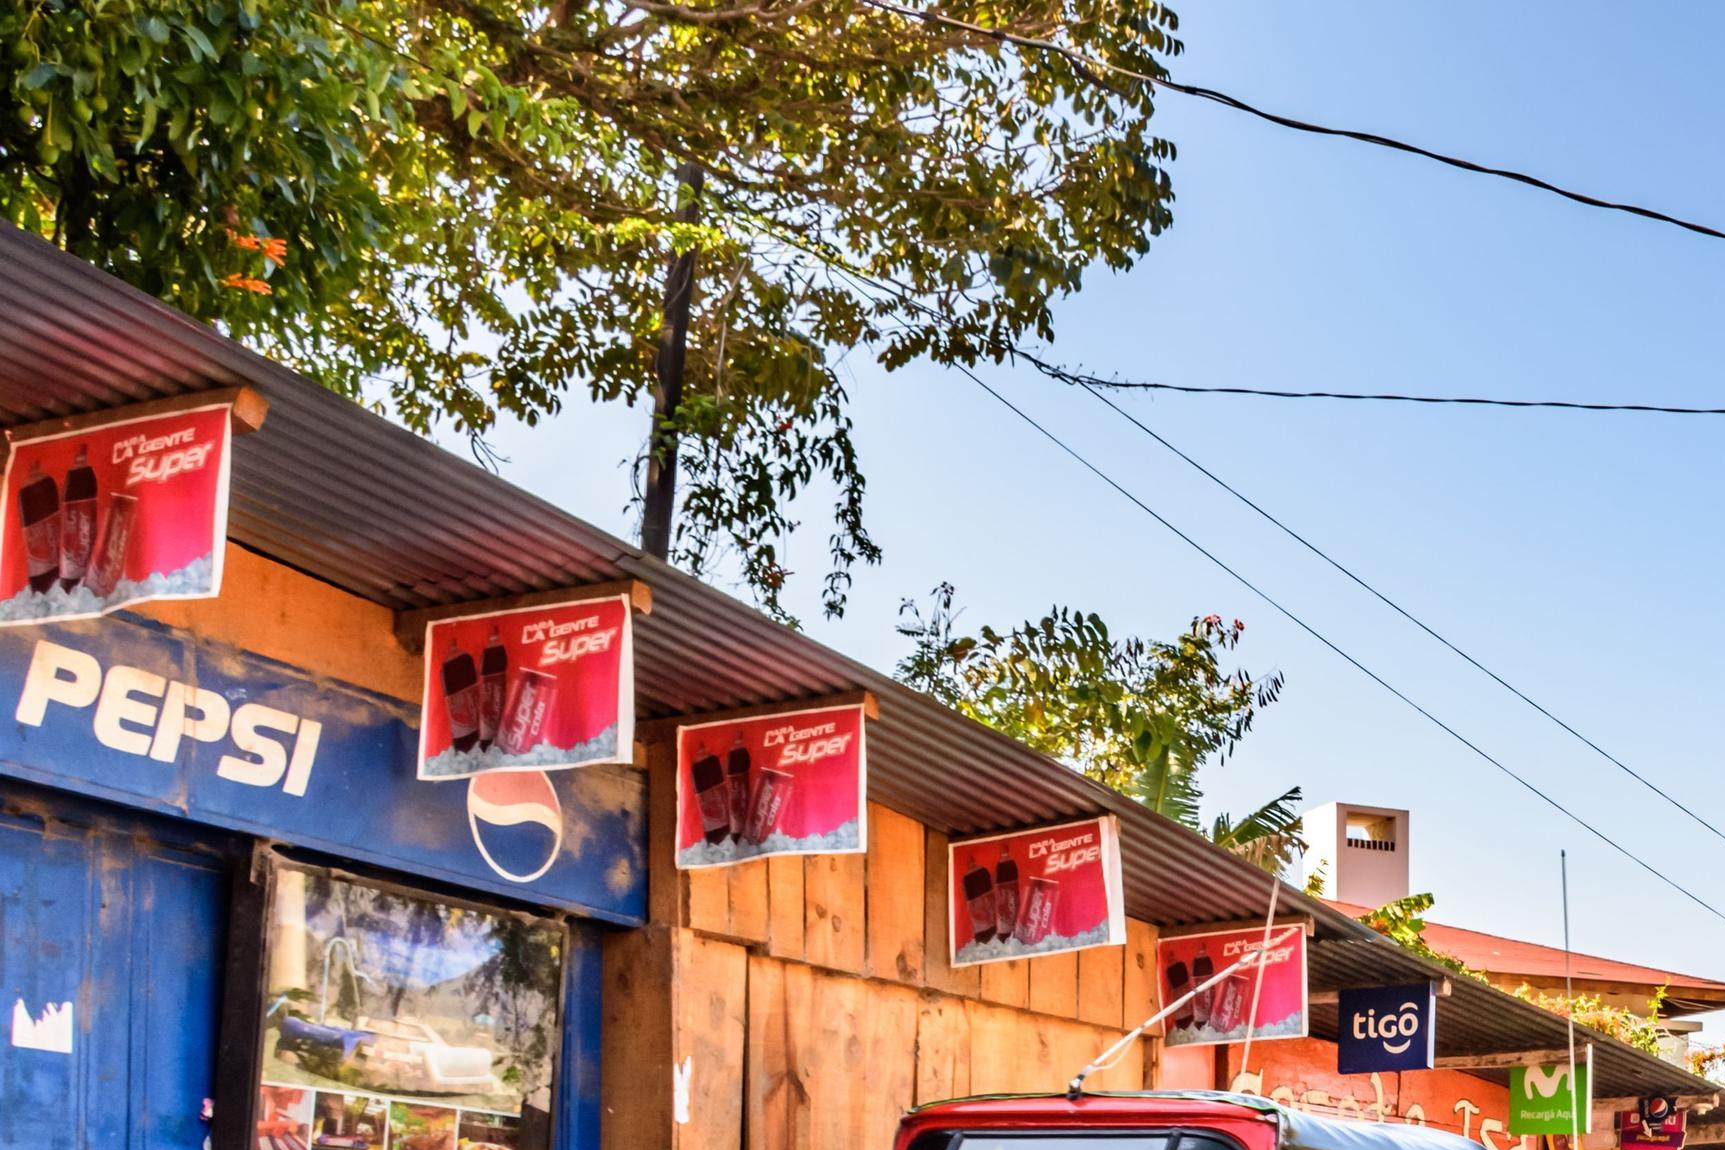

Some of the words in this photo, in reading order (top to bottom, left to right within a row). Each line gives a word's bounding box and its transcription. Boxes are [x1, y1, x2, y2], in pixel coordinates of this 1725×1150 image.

[112, 444, 134, 464] LA
[138, 427, 196, 453] GENTE
[126, 440, 214, 486] Super
[521, 631, 545, 644] LA
[549, 616, 599, 637] GENTE
[538, 627, 618, 666] Super
[15, 639, 323, 797] PEPSI
[763, 733, 785, 747] LA
[789, 722, 836, 742] GENTE
[776, 733, 852, 767] Super
[1029, 848, 1048, 859] LA
[1050, 833, 1093, 852] GENTE
